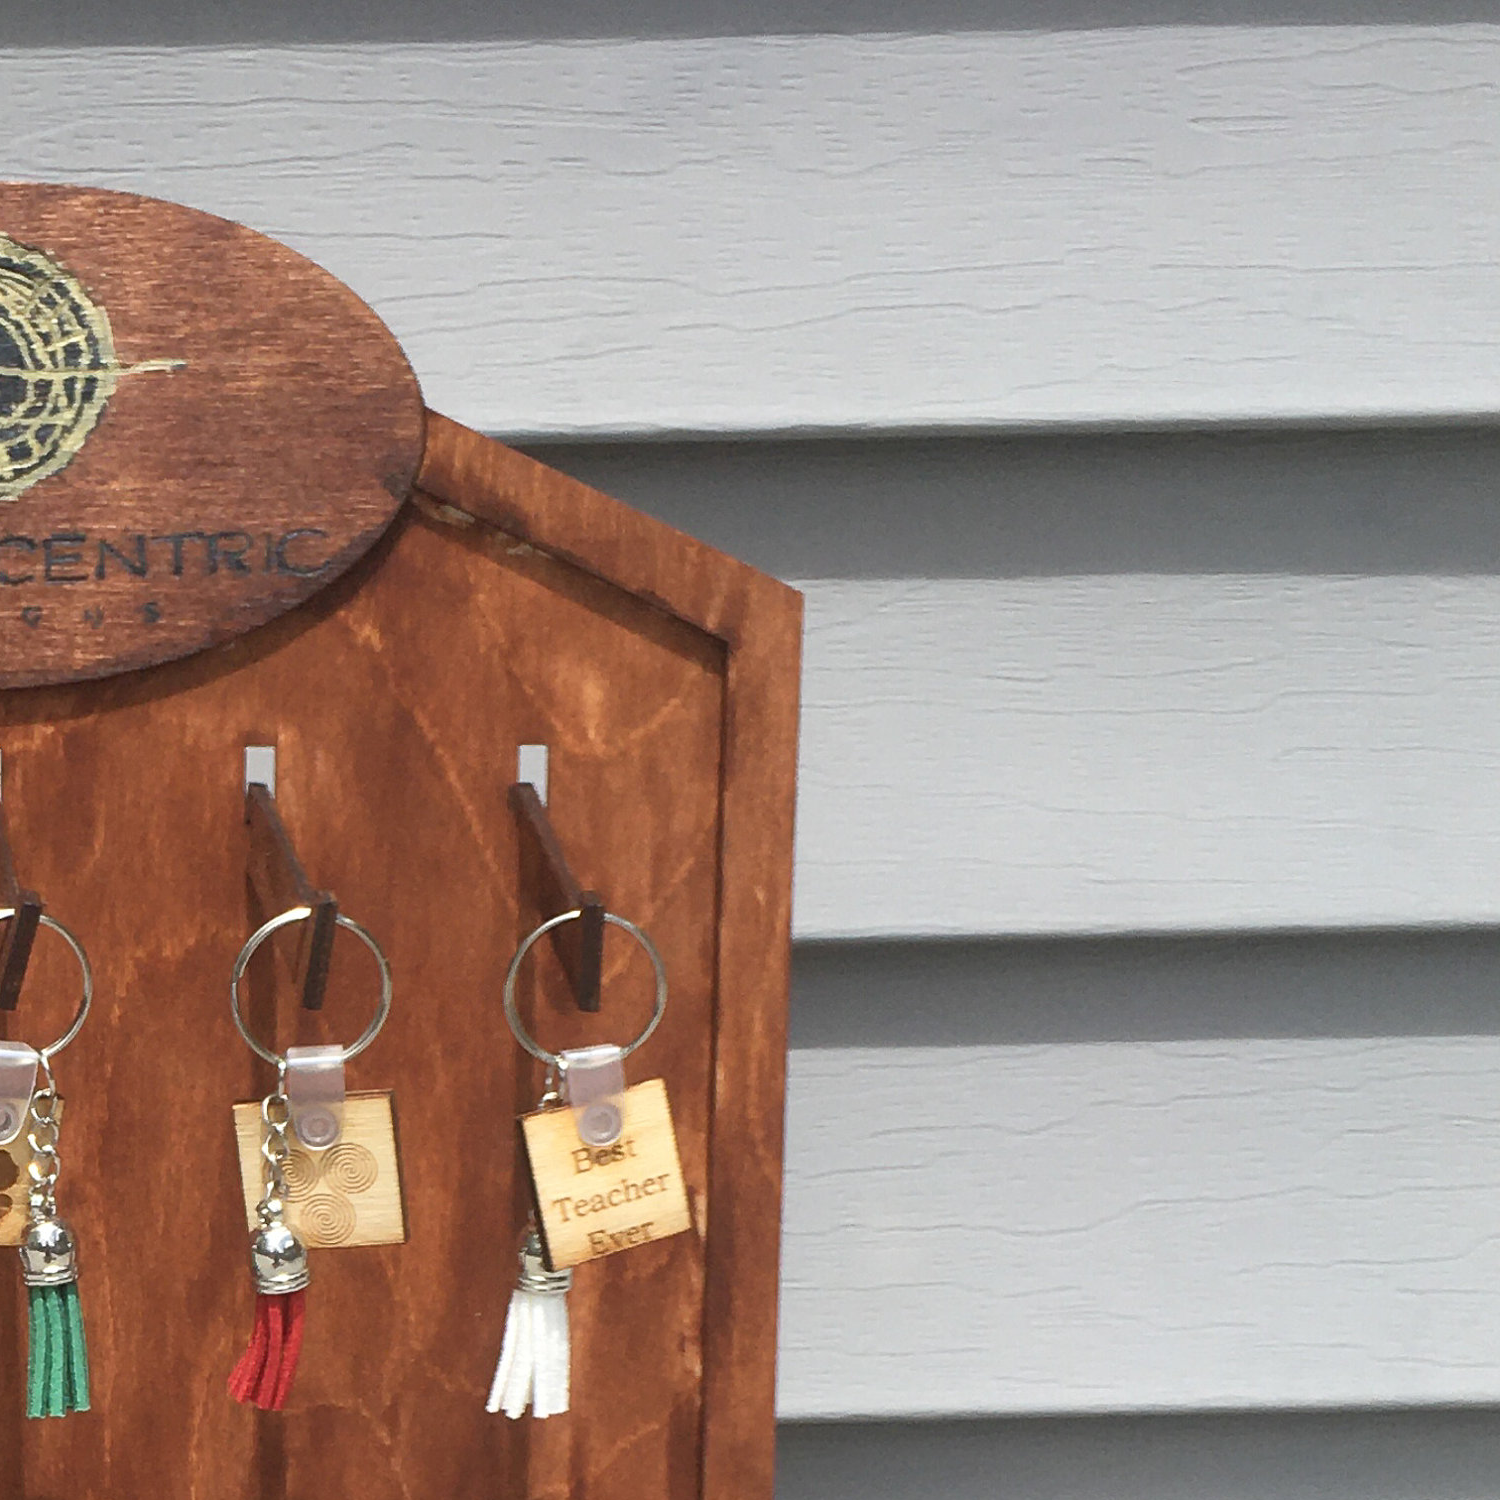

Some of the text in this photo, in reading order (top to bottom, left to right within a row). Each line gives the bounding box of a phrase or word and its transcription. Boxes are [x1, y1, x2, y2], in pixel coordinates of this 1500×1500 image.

[571, 1140, 638, 1175] Best
[553, 1173, 671, 1223] Teacher
[587, 1222, 655, 1256] Ever
